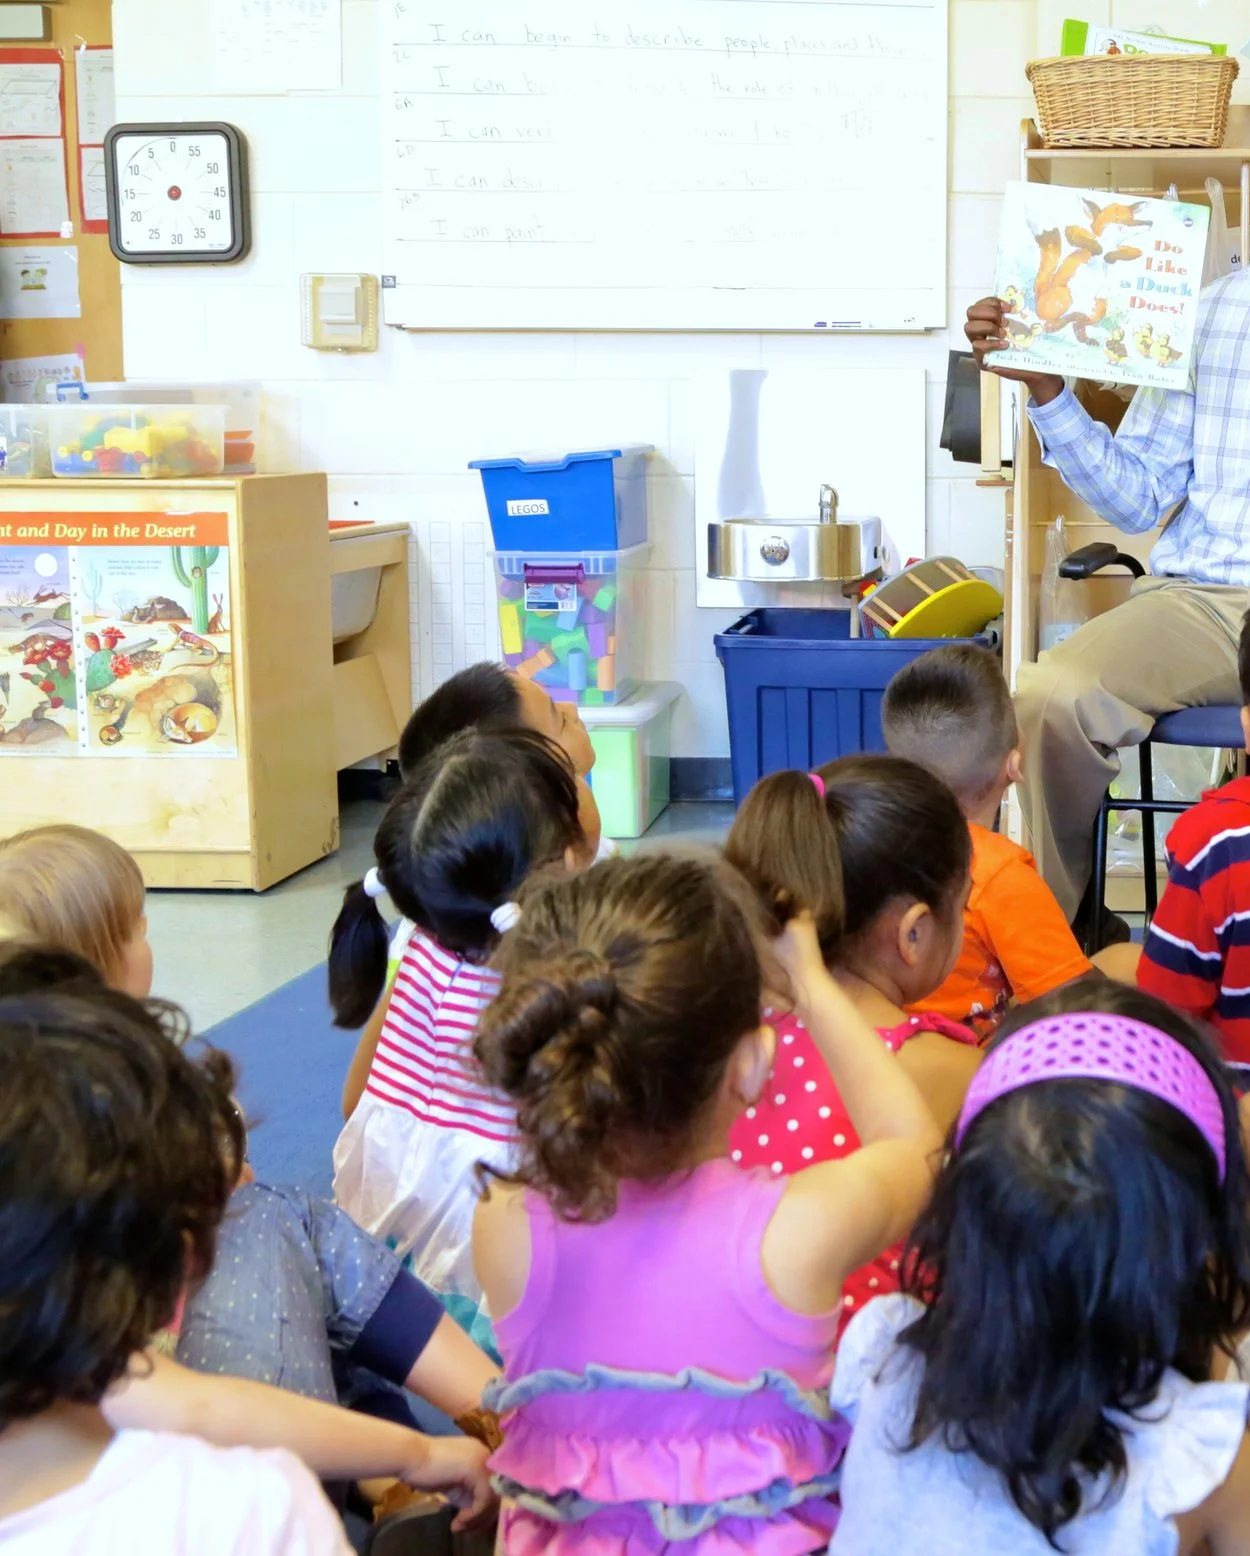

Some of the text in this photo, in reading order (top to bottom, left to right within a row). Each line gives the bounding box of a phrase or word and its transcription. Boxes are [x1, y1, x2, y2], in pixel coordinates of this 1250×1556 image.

[462, 29, 496, 44] can
[524, 23, 572, 51] begin
[590, 20, 611, 43] to
[625, 22, 704, 48] describe
[170, 141, 176, 153] 0
[188, 146, 201, 157] 55
[148, 148, 155, 159] 5
[129, 165, 140, 176] 10
[207, 163, 219, 174] 50
[124, 188, 136, 199] 15
[213, 187, 226, 198] 45
[130, 211, 142, 222] 20
[208, 209, 221, 220] 40
[148, 229, 160, 240] 25
[194, 228, 206, 239] 35
[171, 234, 183, 245] 30
[1154, 240, 1183, 254] Do
[1145, 256, 1188, 275] Like
[1120, 277, 1193, 297] a Duck
[1129, 296, 1185, 315] Does!
[511, 503, 546, 515] LEGOS
[17, 523, 50, 538] and
[54, 523, 87, 542] Day
[91, 523, 108, 538] in
[113, 523, 140, 538] the
[145, 523, 196, 538] Desert
